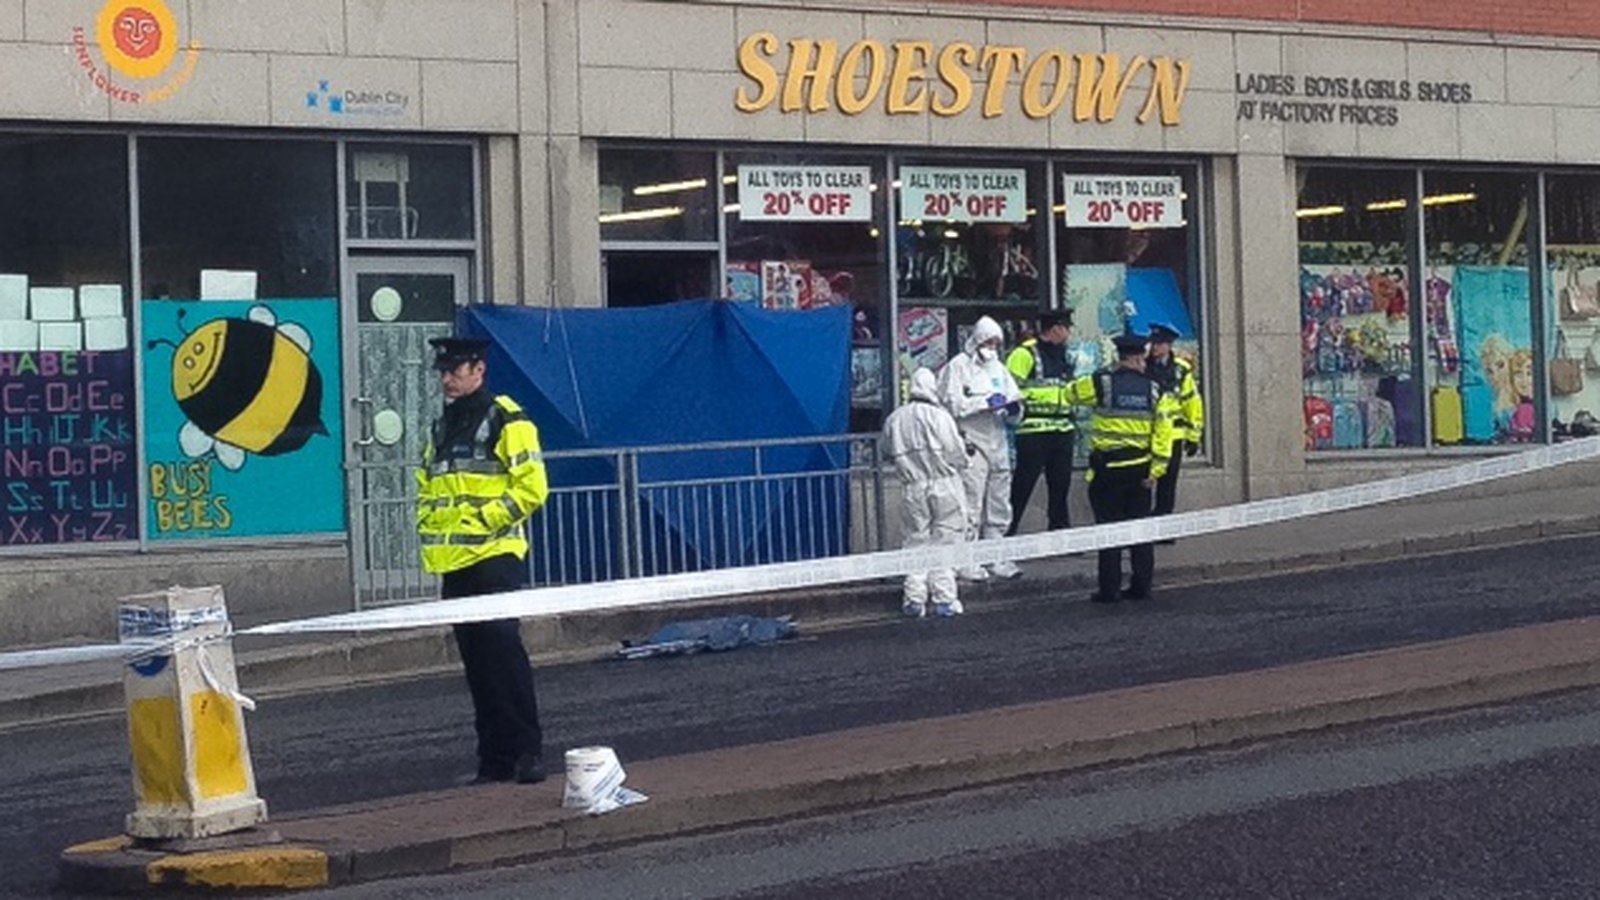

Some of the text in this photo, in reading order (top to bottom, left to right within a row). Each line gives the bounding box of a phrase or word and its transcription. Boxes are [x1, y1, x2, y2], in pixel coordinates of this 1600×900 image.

[73, 27, 141, 103] SUNFLOWER
[735, 31, 1194, 127] SHOESTOWN
[1235, 73, 1295, 95] LADIES
[1417, 81, 1472, 103] SHOES
[1236, 101, 1399, 126] AT FACTORY PRICES
[748, 171, 862, 187] ALL TOYS TO CLEAR
[909, 173, 1019, 190] ALL TOYS TO CLEAR
[1073, 181, 1175, 196] ALL TOYS TO CLEAR
[808, 193, 851, 215] OFF
[966, 194, 1007, 217] OFF
[1127, 201, 1165, 222] OFF
[150, 460, 212, 499] BUSY
[156, 494, 232, 533] BEES
